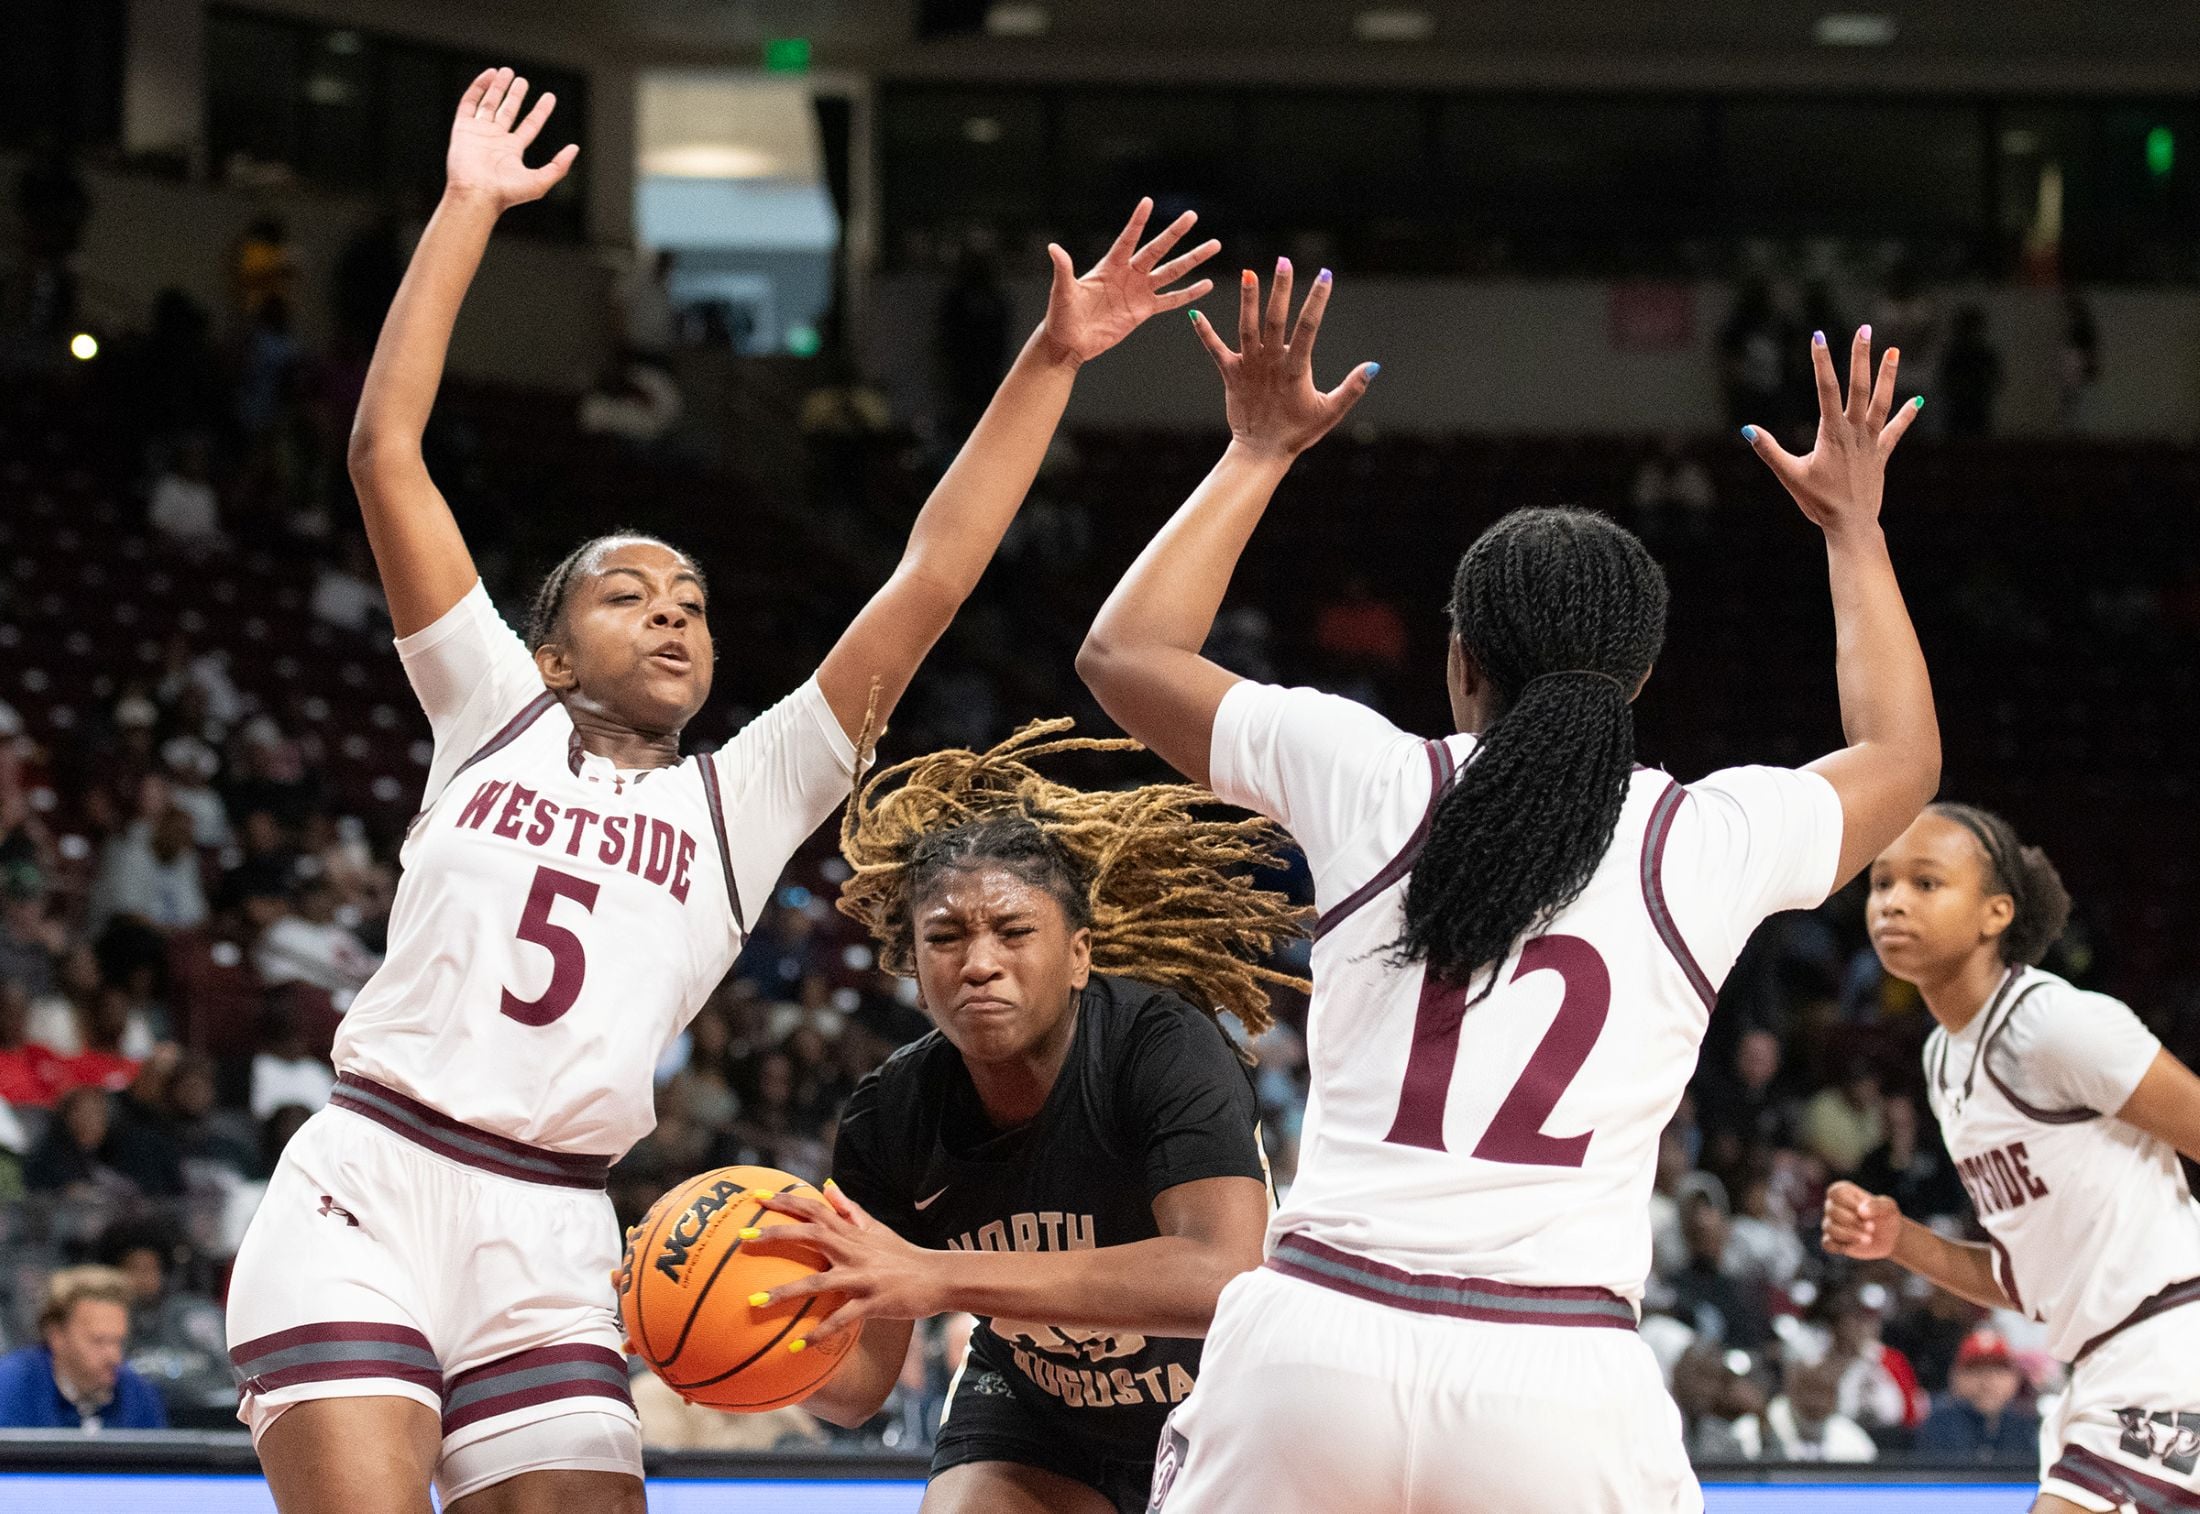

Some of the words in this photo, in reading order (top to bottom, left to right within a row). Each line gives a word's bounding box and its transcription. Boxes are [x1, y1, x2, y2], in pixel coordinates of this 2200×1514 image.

[455, 779, 697, 905] WESTSIDE
[500, 865, 601, 1027] 5
[1382, 934, 1611, 1168] 12
[655, 1180, 747, 1285] NCAA
[1010, 1342, 1197, 1408] AUGUSTA
